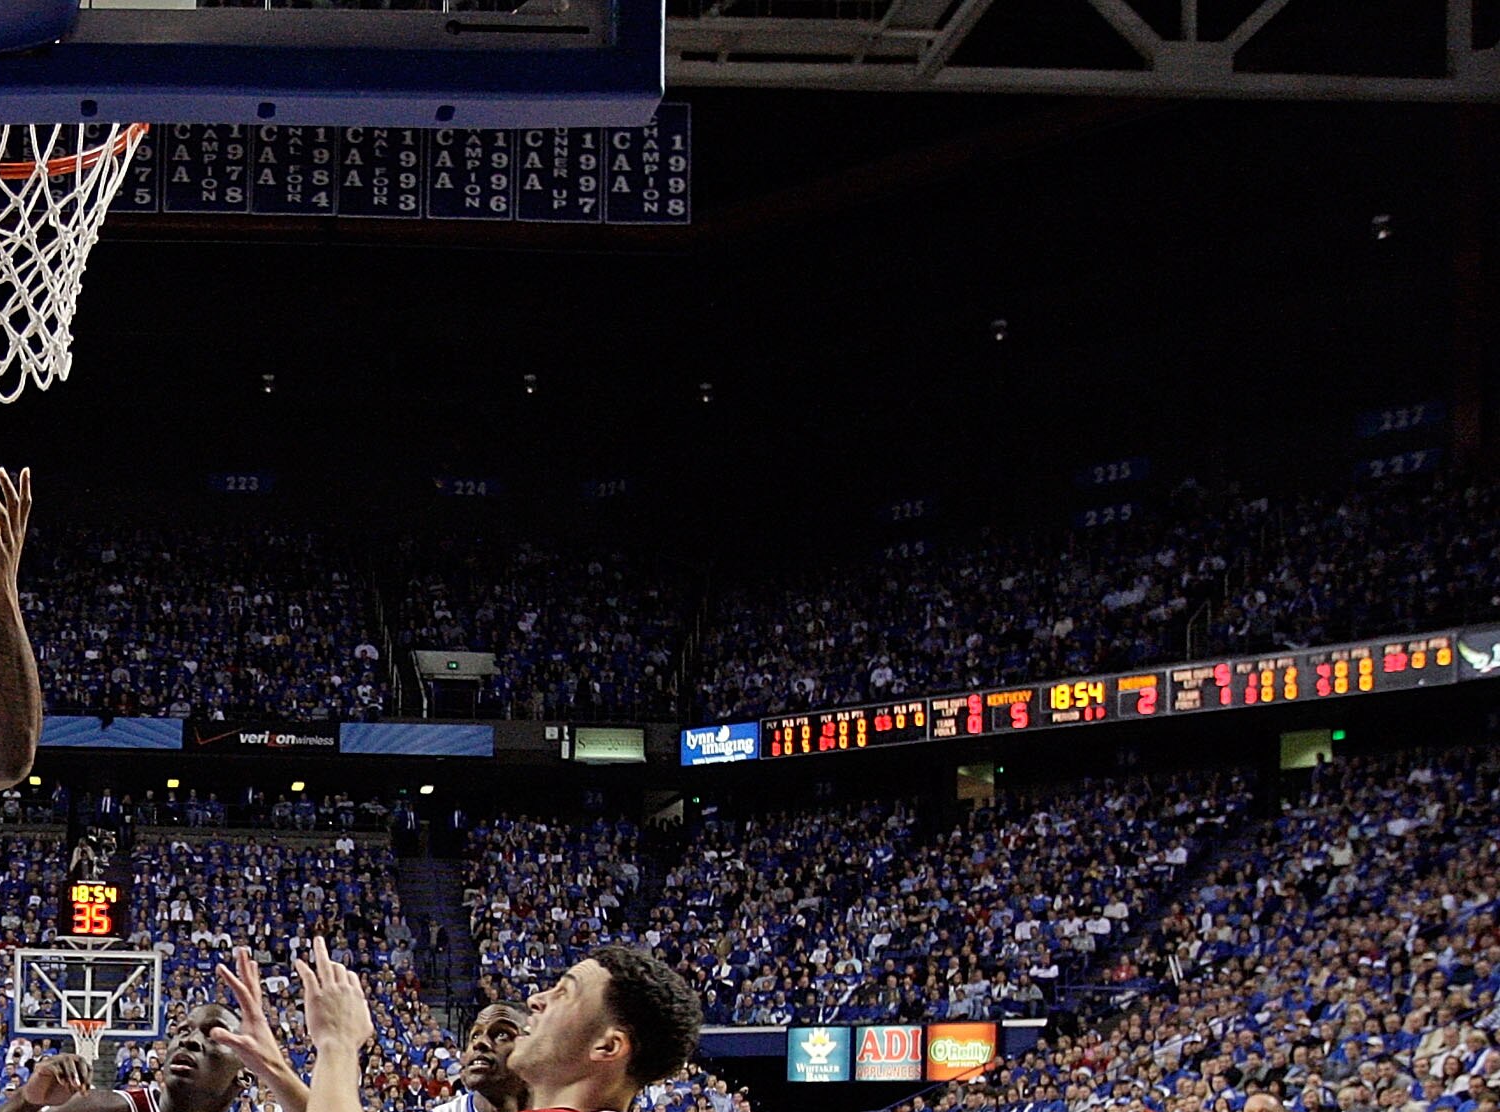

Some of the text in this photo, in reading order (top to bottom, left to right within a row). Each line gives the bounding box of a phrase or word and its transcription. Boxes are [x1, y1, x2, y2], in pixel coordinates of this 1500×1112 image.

[225, 124, 244, 203] 1978
[312, 127, 330, 207] 1984
[399, 130, 417, 211] 1993
[490, 132, 508, 212] 1996
[578, 133, 596, 214] 1997
[668, 135, 687, 216] 1998
[287, 165, 304, 203] FOUR
[373, 167, 389, 206] FOUR
[1051, 681, 1104, 710] 18:54
[1137, 687, 1157, 715] 2
[1010, 702, 1028, 729] 5
[686, 730, 715, 750] lynn
[702, 738, 754, 756] imaging
[71, 885, 117, 903] 18:54
[73, 903, 111, 935] 35
[857, 1028, 921, 1063] ADI
[930, 1039, 992, 1064] O'Reilly
[855, 1065, 921, 1079] APPLIANCES
